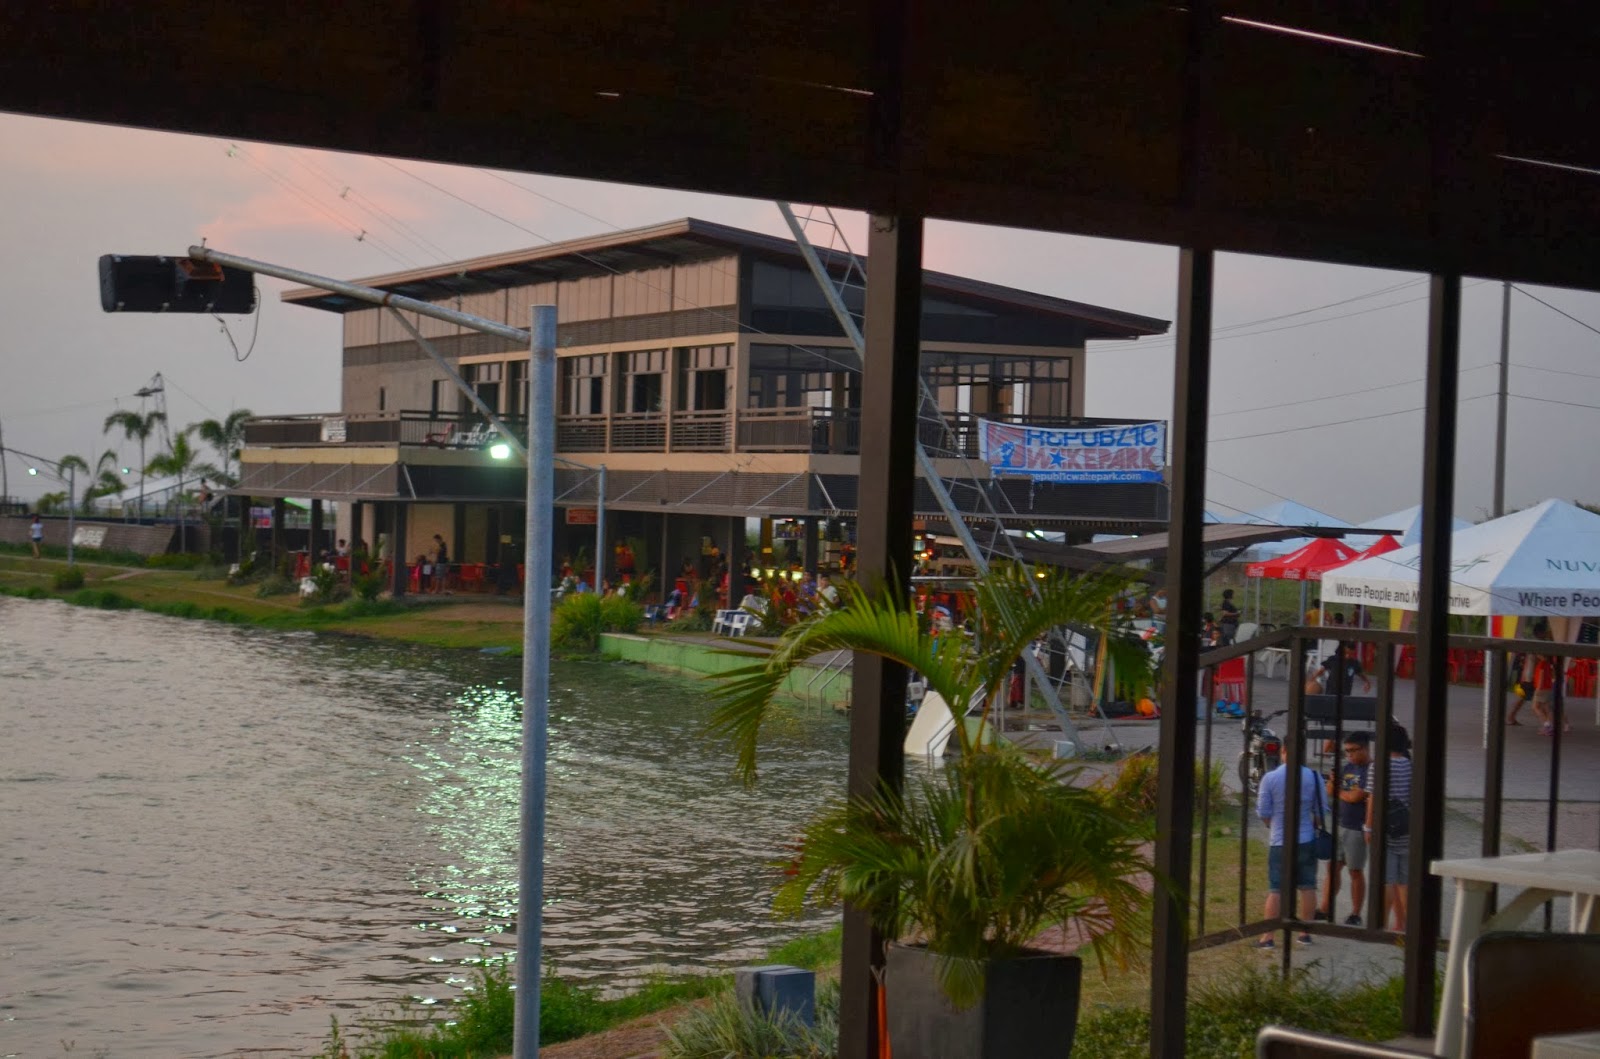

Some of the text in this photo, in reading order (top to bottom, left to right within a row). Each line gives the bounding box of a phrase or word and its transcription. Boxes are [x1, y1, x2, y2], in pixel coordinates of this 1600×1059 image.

[1545, 558, 1600, 572] NUV
[1336, 583, 1363, 599] Where
[1364, 585, 1392, 603] People
[1394, 589, 1410, 603] and
[1518, 591, 1568, 608] Where
